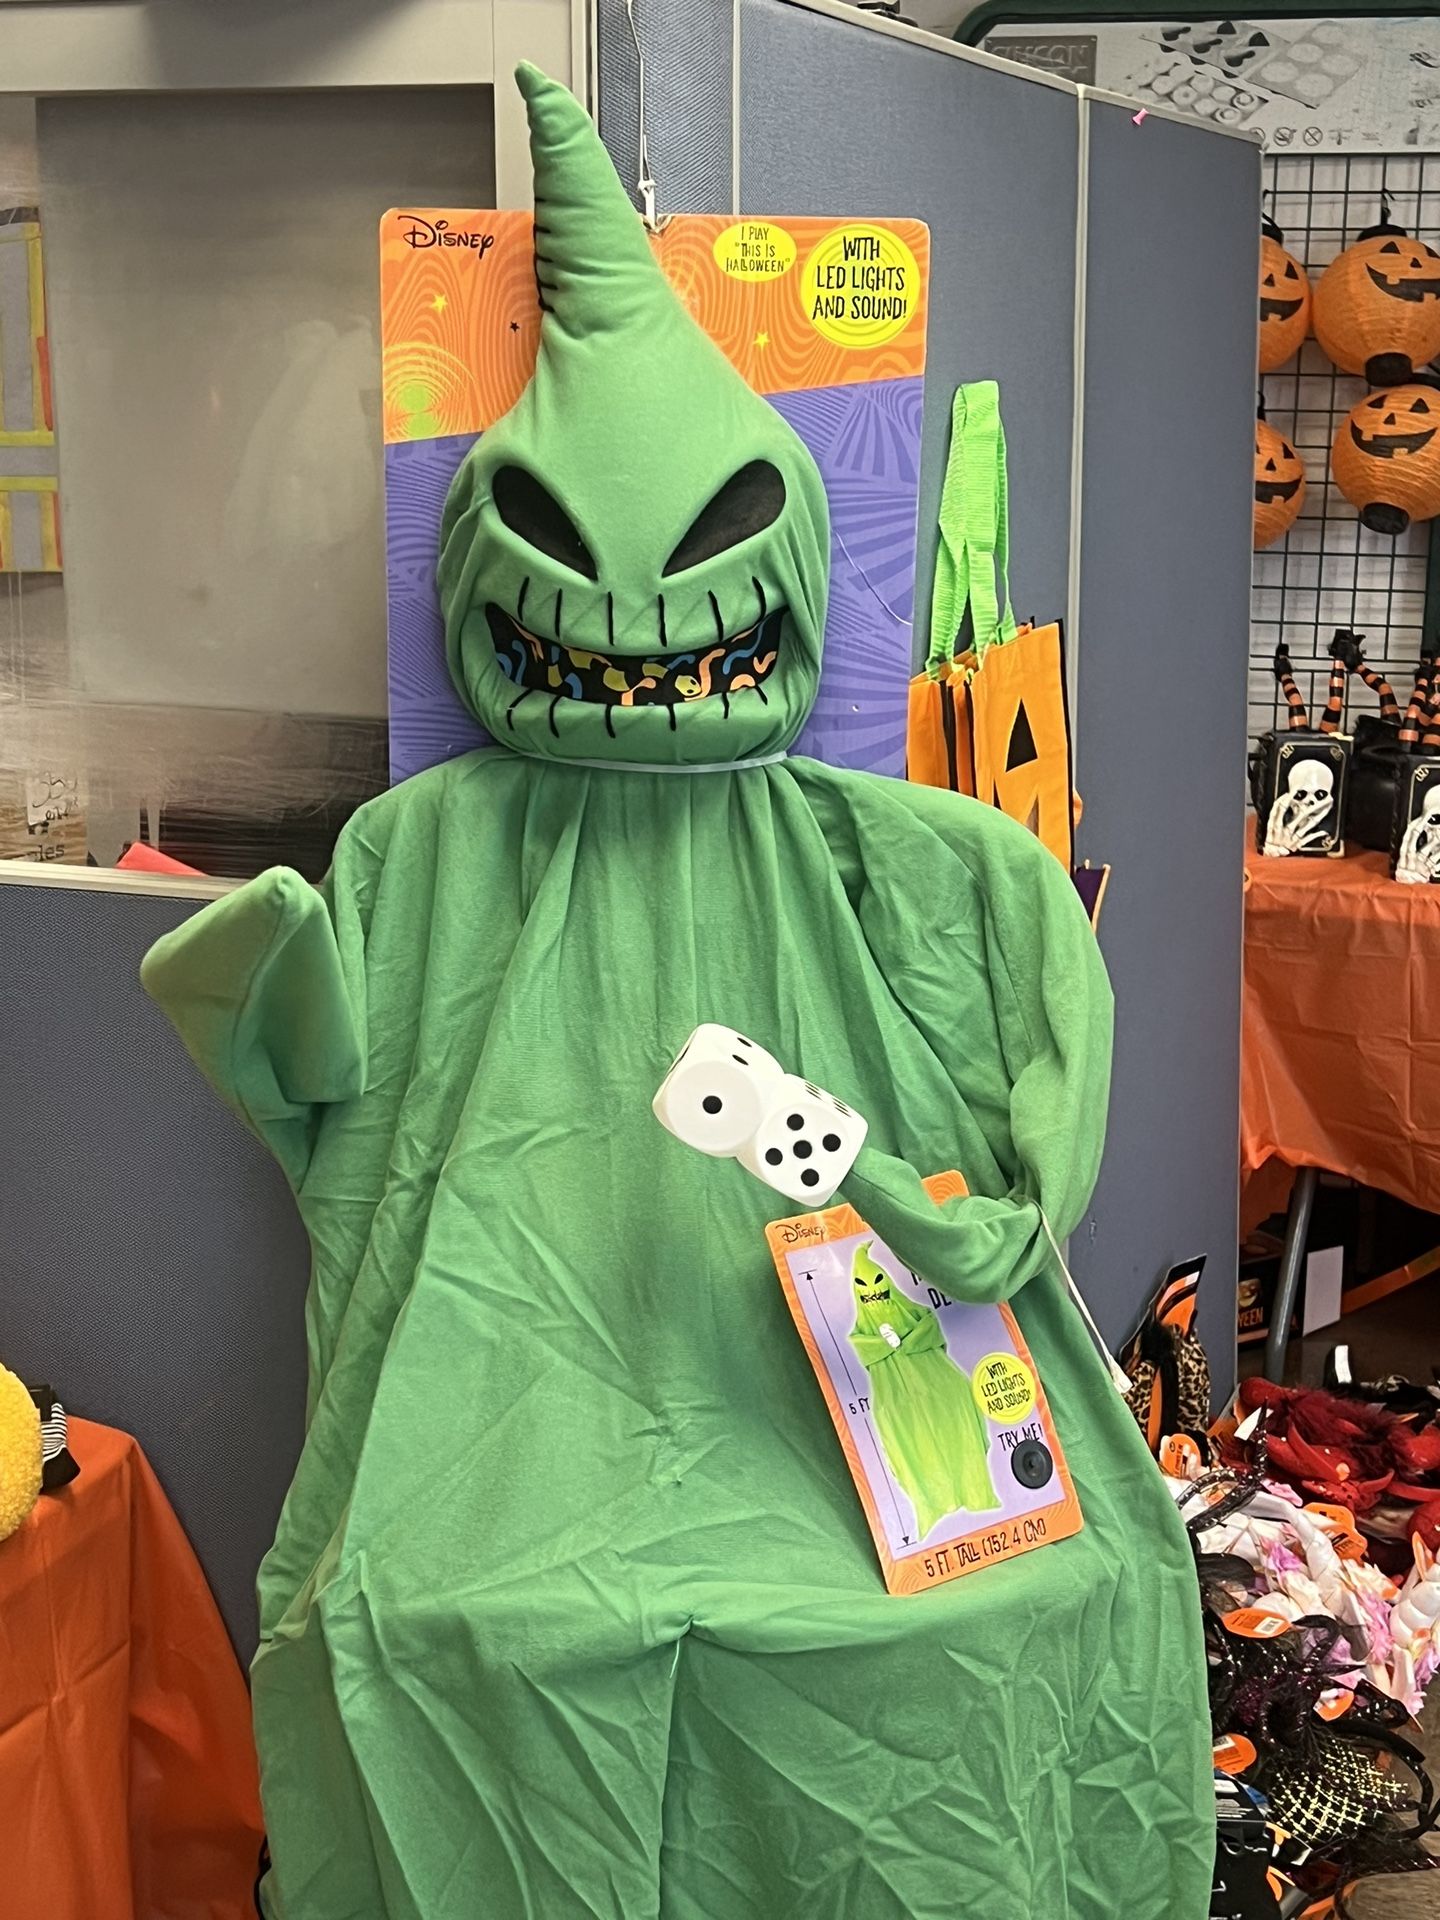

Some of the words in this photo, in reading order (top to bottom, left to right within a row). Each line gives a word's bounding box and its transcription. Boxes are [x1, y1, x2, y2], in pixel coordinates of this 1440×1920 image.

[741, 226, 745, 240] I
[749, 226, 769, 240] PLAY
[765, 243, 776, 257] IS
[843, 236, 880, 261] WITH
[817, 265, 846, 289] LED
[852, 266, 905, 292] LIGHTS
[812, 295, 845, 320] AND
[851, 296, 907, 320] SOUND!
[986, 1362, 1007, 1379] WITH
[981, 1382, 998, 1397] LED
[999, 1373, 1026, 1392] LIGHTS
[987, 1398, 1004, 1414] AND
[1004, 1388, 1031, 1408] SOUND!
[997, 1431, 1019, 1451] TRY
[1022, 1423, 1043, 1441] ME!
[924, 1559, 935, 1577] 5
[935, 1549, 955, 1575] FT.
[953, 1542, 981, 1567] TALL
[1023, 1518, 1047, 1542] CM)
